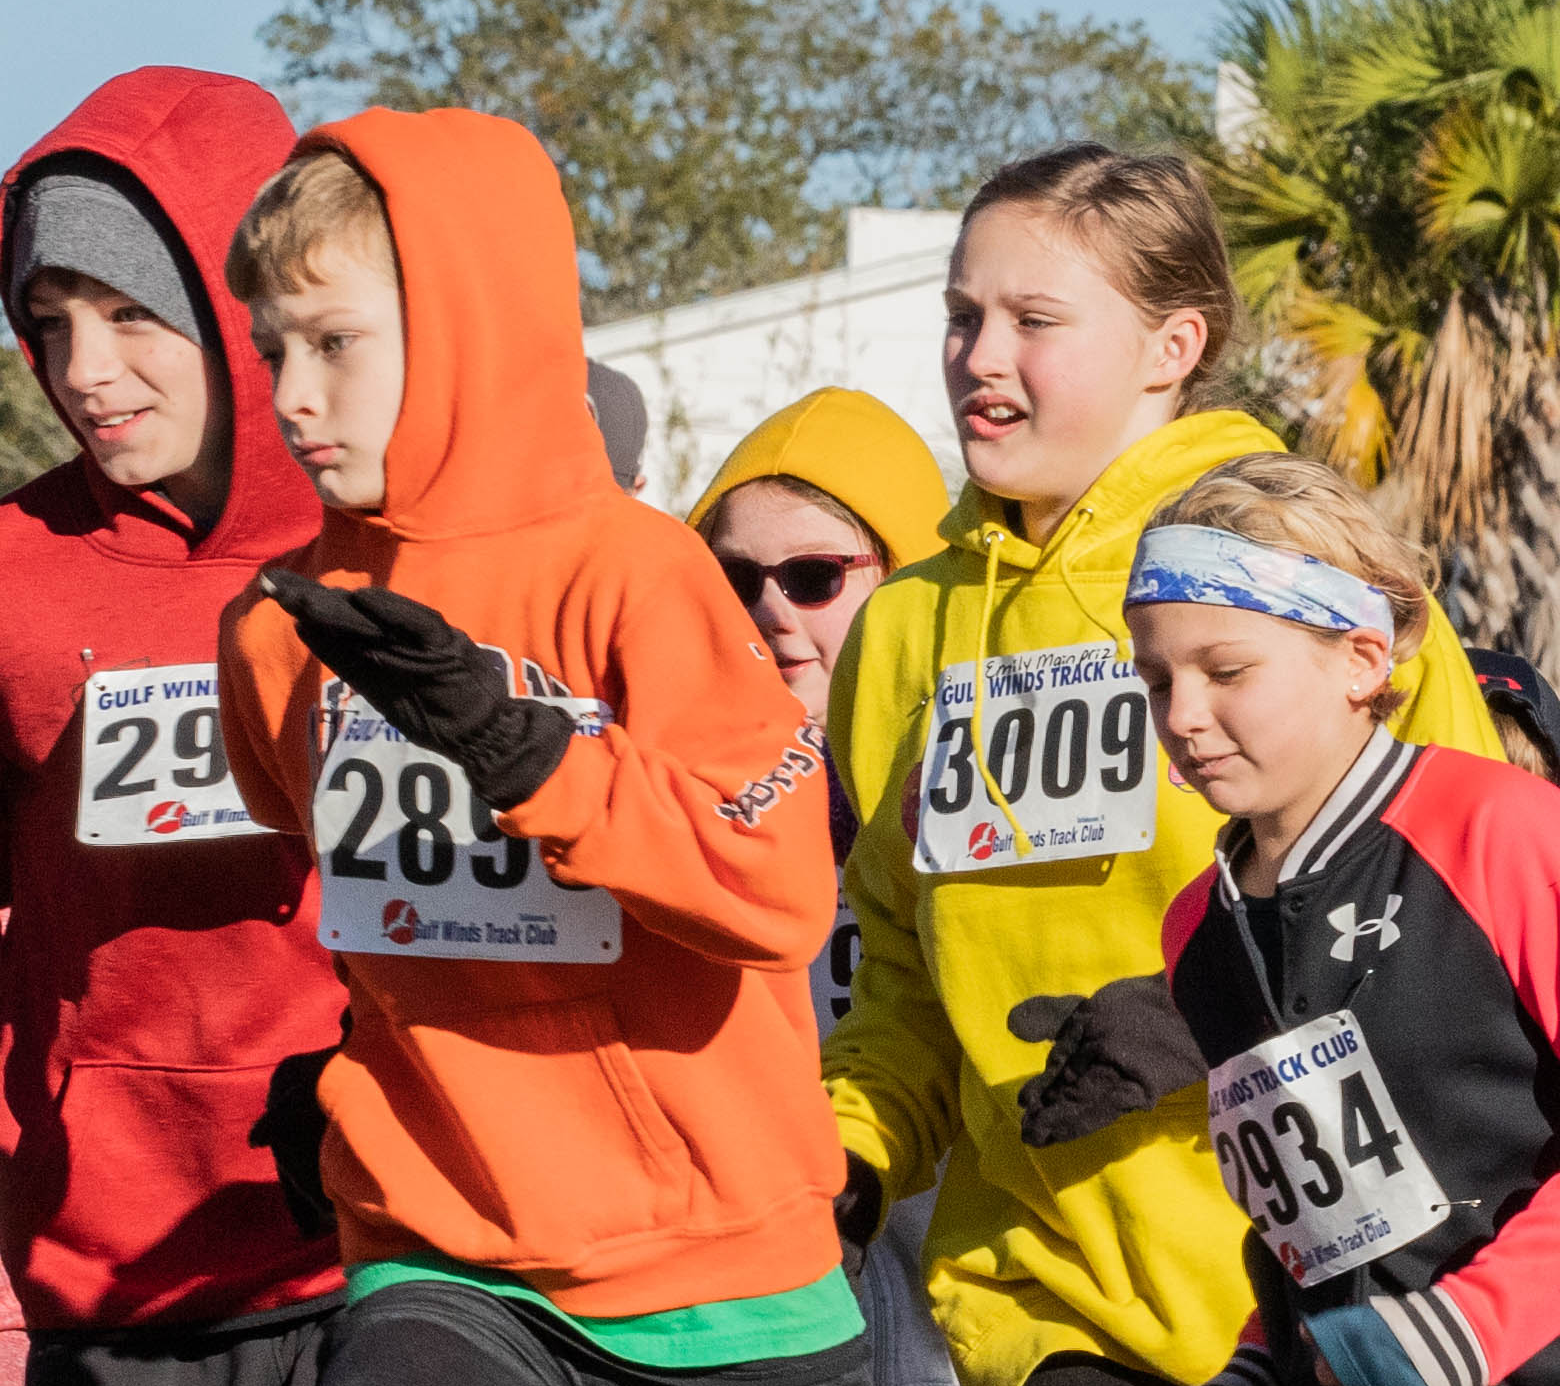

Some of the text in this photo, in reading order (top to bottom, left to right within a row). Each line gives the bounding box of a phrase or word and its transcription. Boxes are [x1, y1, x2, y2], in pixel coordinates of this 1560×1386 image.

[98, 679, 219, 710] GULF WIN
[942, 660, 1138, 706] GUL WINDS TRACK CL
[985, 656, 1032, 679] Emily
[93, 707, 228, 801] 29
[930, 692, 1147, 814] 3009
[327, 758, 602, 890] 289
[992, 832, 1014, 853] Gulf
[1049, 828, 1077, 845] Track
[1080, 823, 1104, 842] Club
[486, 921, 521, 945] Track
[525, 922, 557, 945] Club
[1251, 1053, 1309, 1094] TRACK
[1311, 1029, 1359, 1068] CLUB
[1216, 1070, 1404, 1233] 2934
